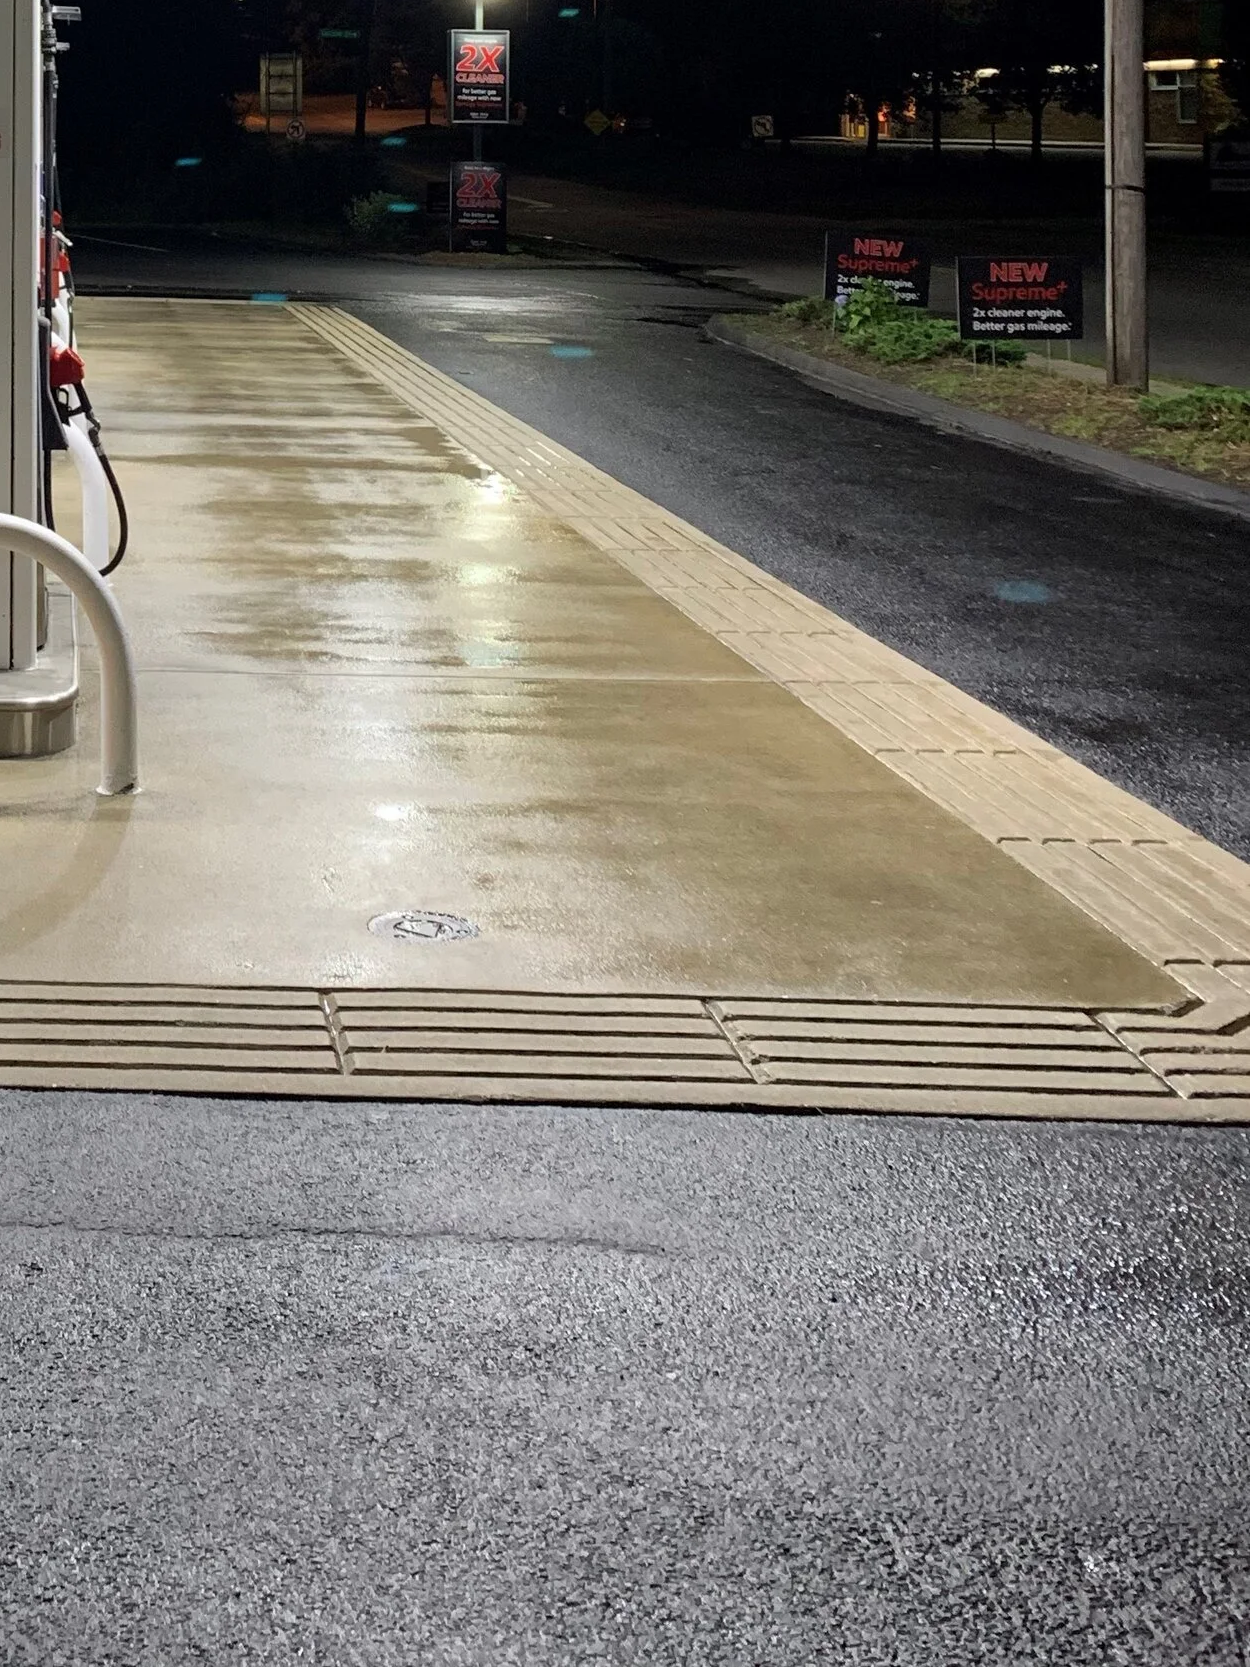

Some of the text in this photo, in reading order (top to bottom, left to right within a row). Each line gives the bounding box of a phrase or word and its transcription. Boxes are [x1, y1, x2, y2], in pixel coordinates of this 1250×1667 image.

[456, 43, 505, 72] 2X
[455, 72, 505, 84] CLEANER
[456, 171, 501, 198] 2X
[456, 198, 502, 209] CLEANER
[854, 237, 904, 257] NEW
[990, 262, 1048, 282] NEW
[838, 274, 848, 283] 2x
[883, 279, 915, 289] engine.
[972, 280, 1068, 304] Supreme+
[973, 307, 1065, 320] 2x cleaner engine.
[973, 321, 1005, 331] Better
[1007, 323, 1025, 333] gas
